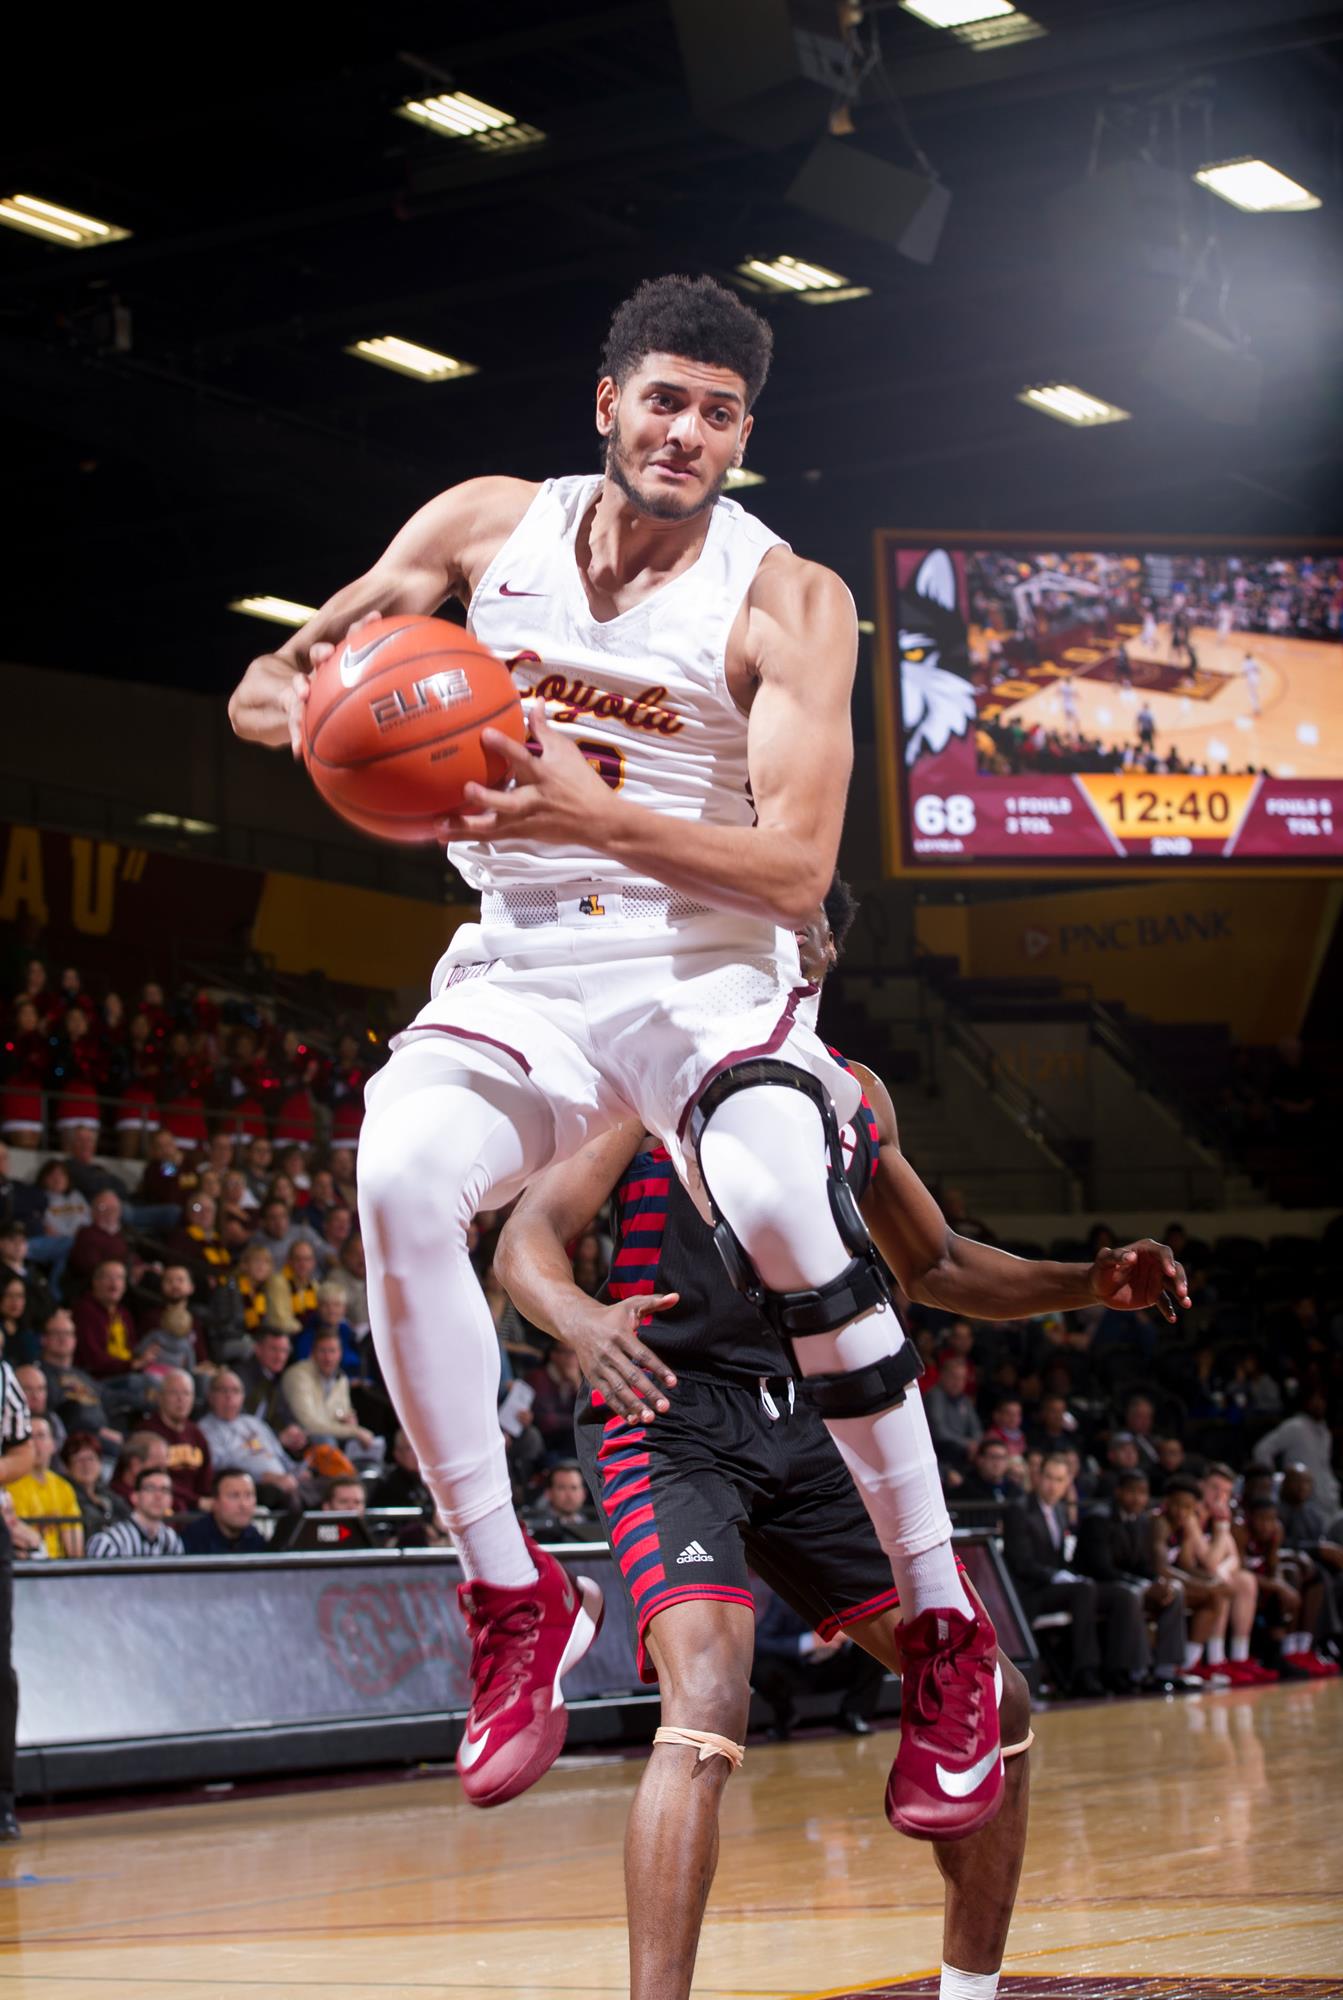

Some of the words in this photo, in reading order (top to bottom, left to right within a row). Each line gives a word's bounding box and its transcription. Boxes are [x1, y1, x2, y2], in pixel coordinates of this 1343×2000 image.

[371, 668, 473, 727] ELITE
[913, 794, 976, 836] 68
[1019, 797, 1072, 814] FOULS
[1109, 791, 1230, 822] 12:40
[1266, 798, 1318, 815] FOULS
[1059, 918, 1131, 954] PNC
[1137, 909, 1234, 946] BANK
[676, 1554, 714, 1564] adidas
